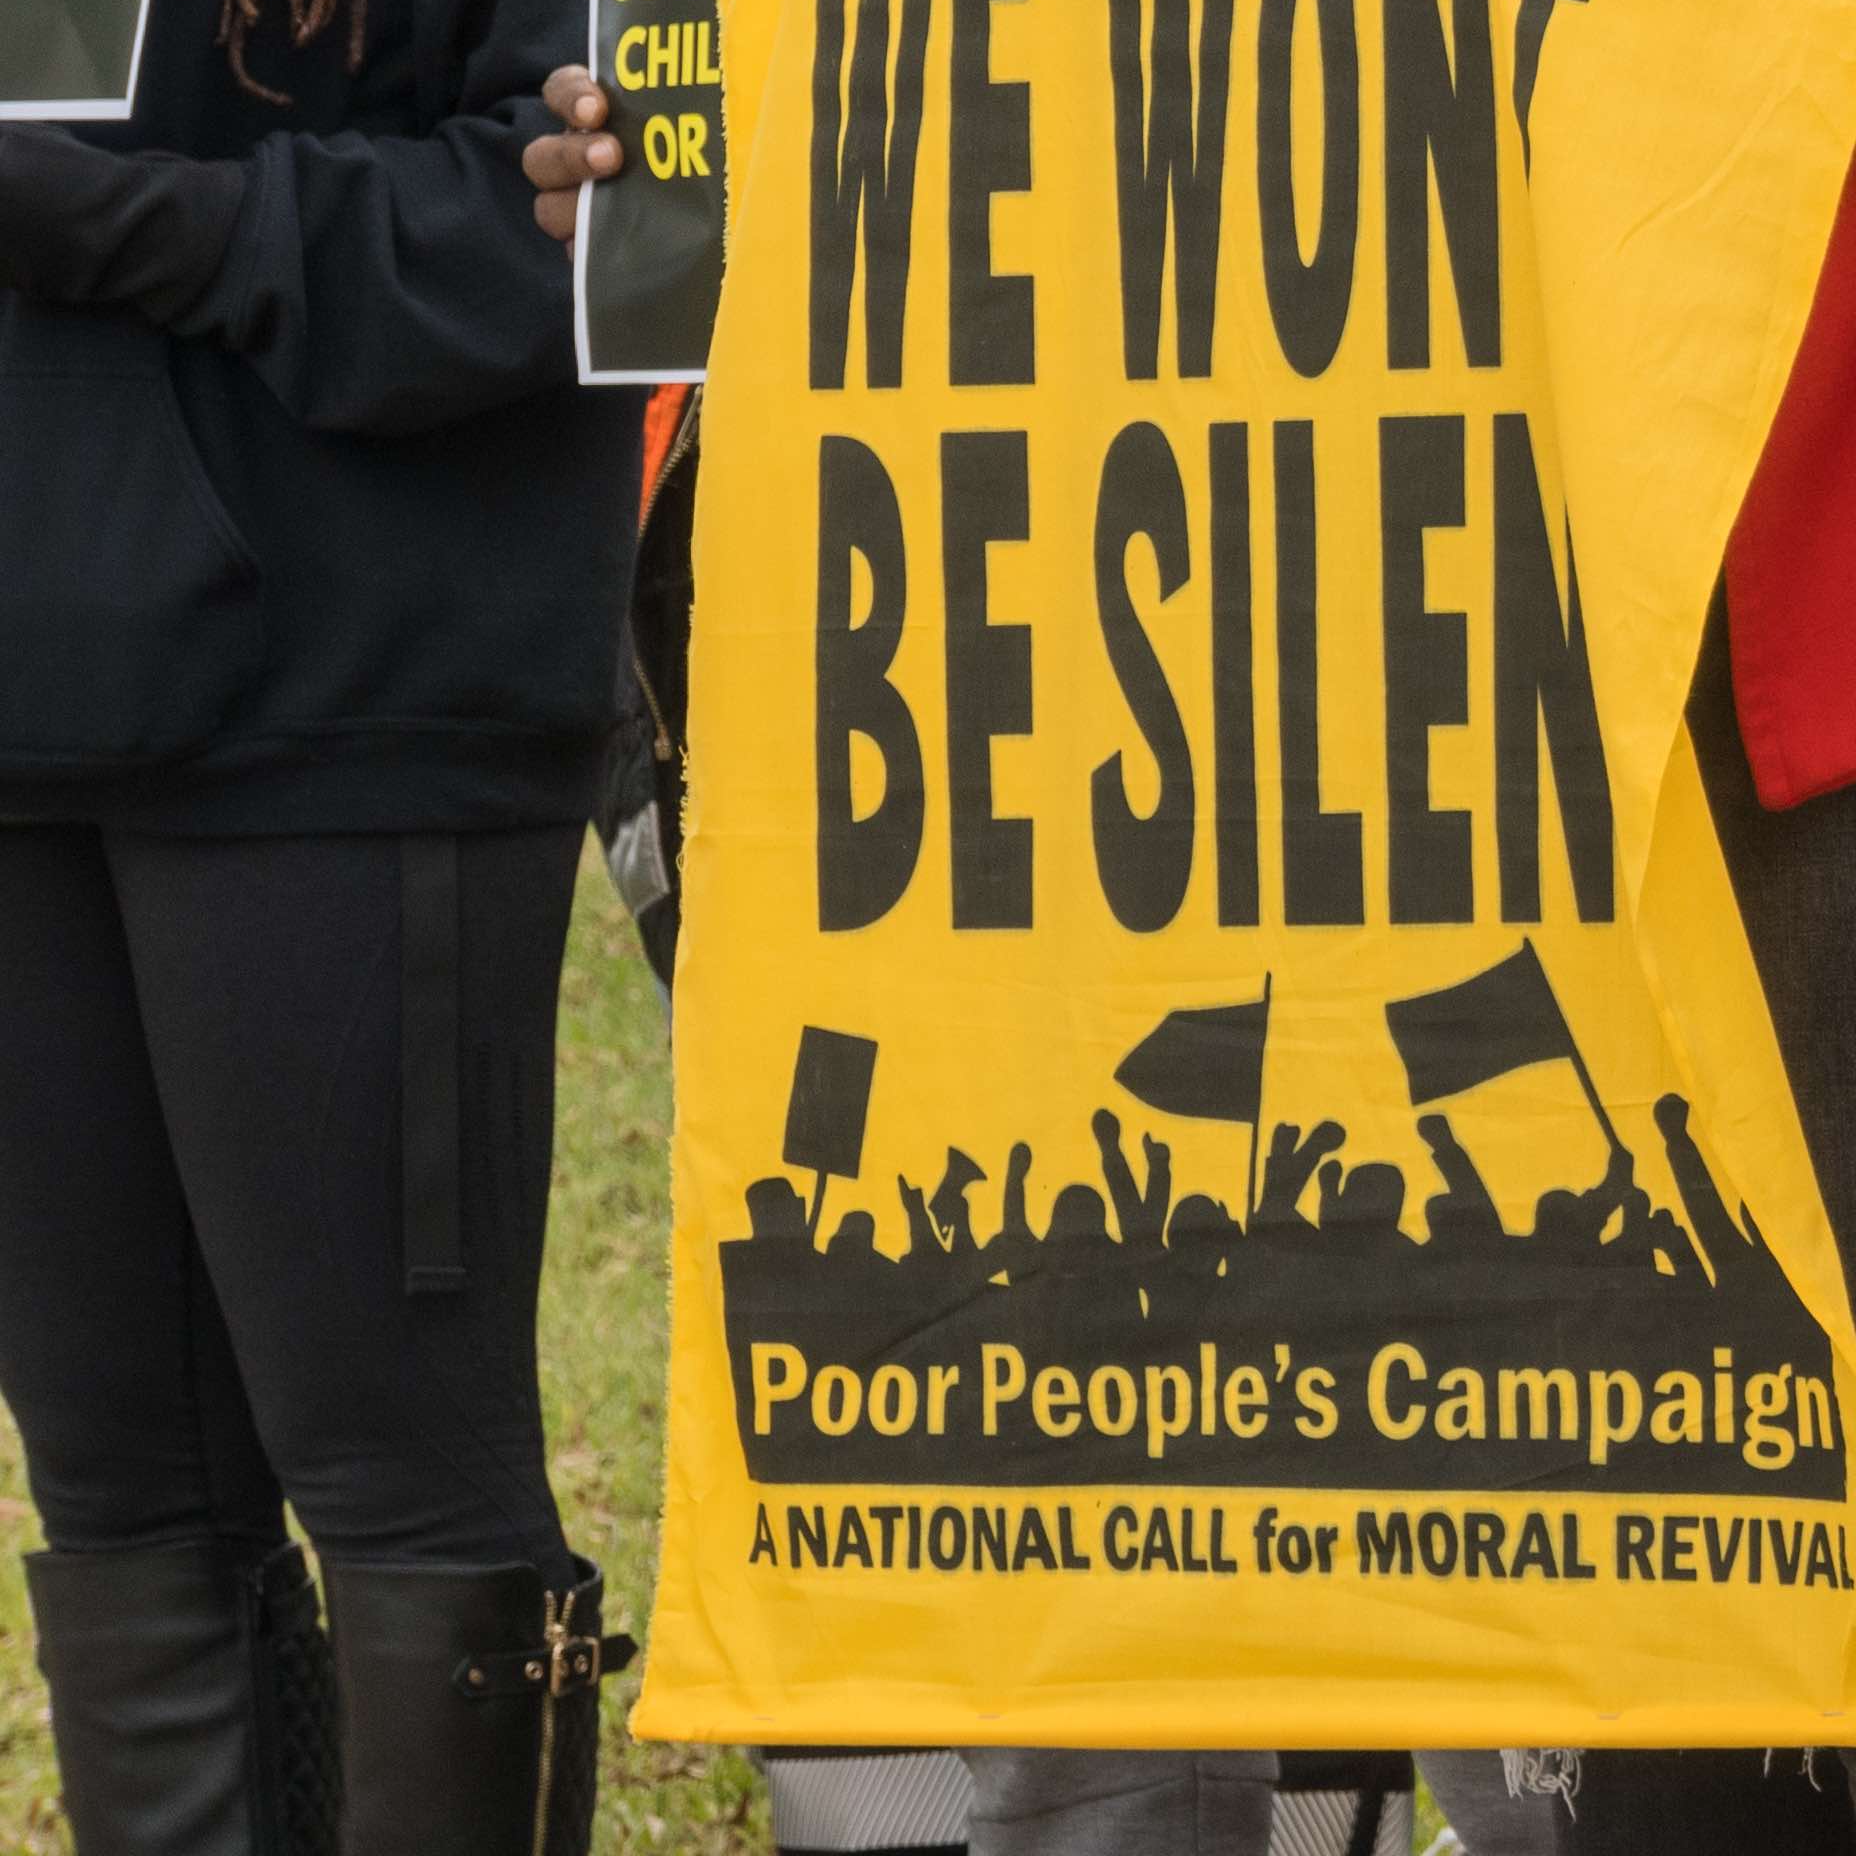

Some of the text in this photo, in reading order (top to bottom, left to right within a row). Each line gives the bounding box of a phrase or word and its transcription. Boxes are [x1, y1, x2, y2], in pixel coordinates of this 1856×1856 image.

[643, 112, 711, 180] OR
[815, 429, 1036, 935] BE
[752, 1341, 1838, 1471] Poor People's Campaign
[749, 1502, 1856, 1590] A NATIONAL CALL for MORAL REVIVAL
